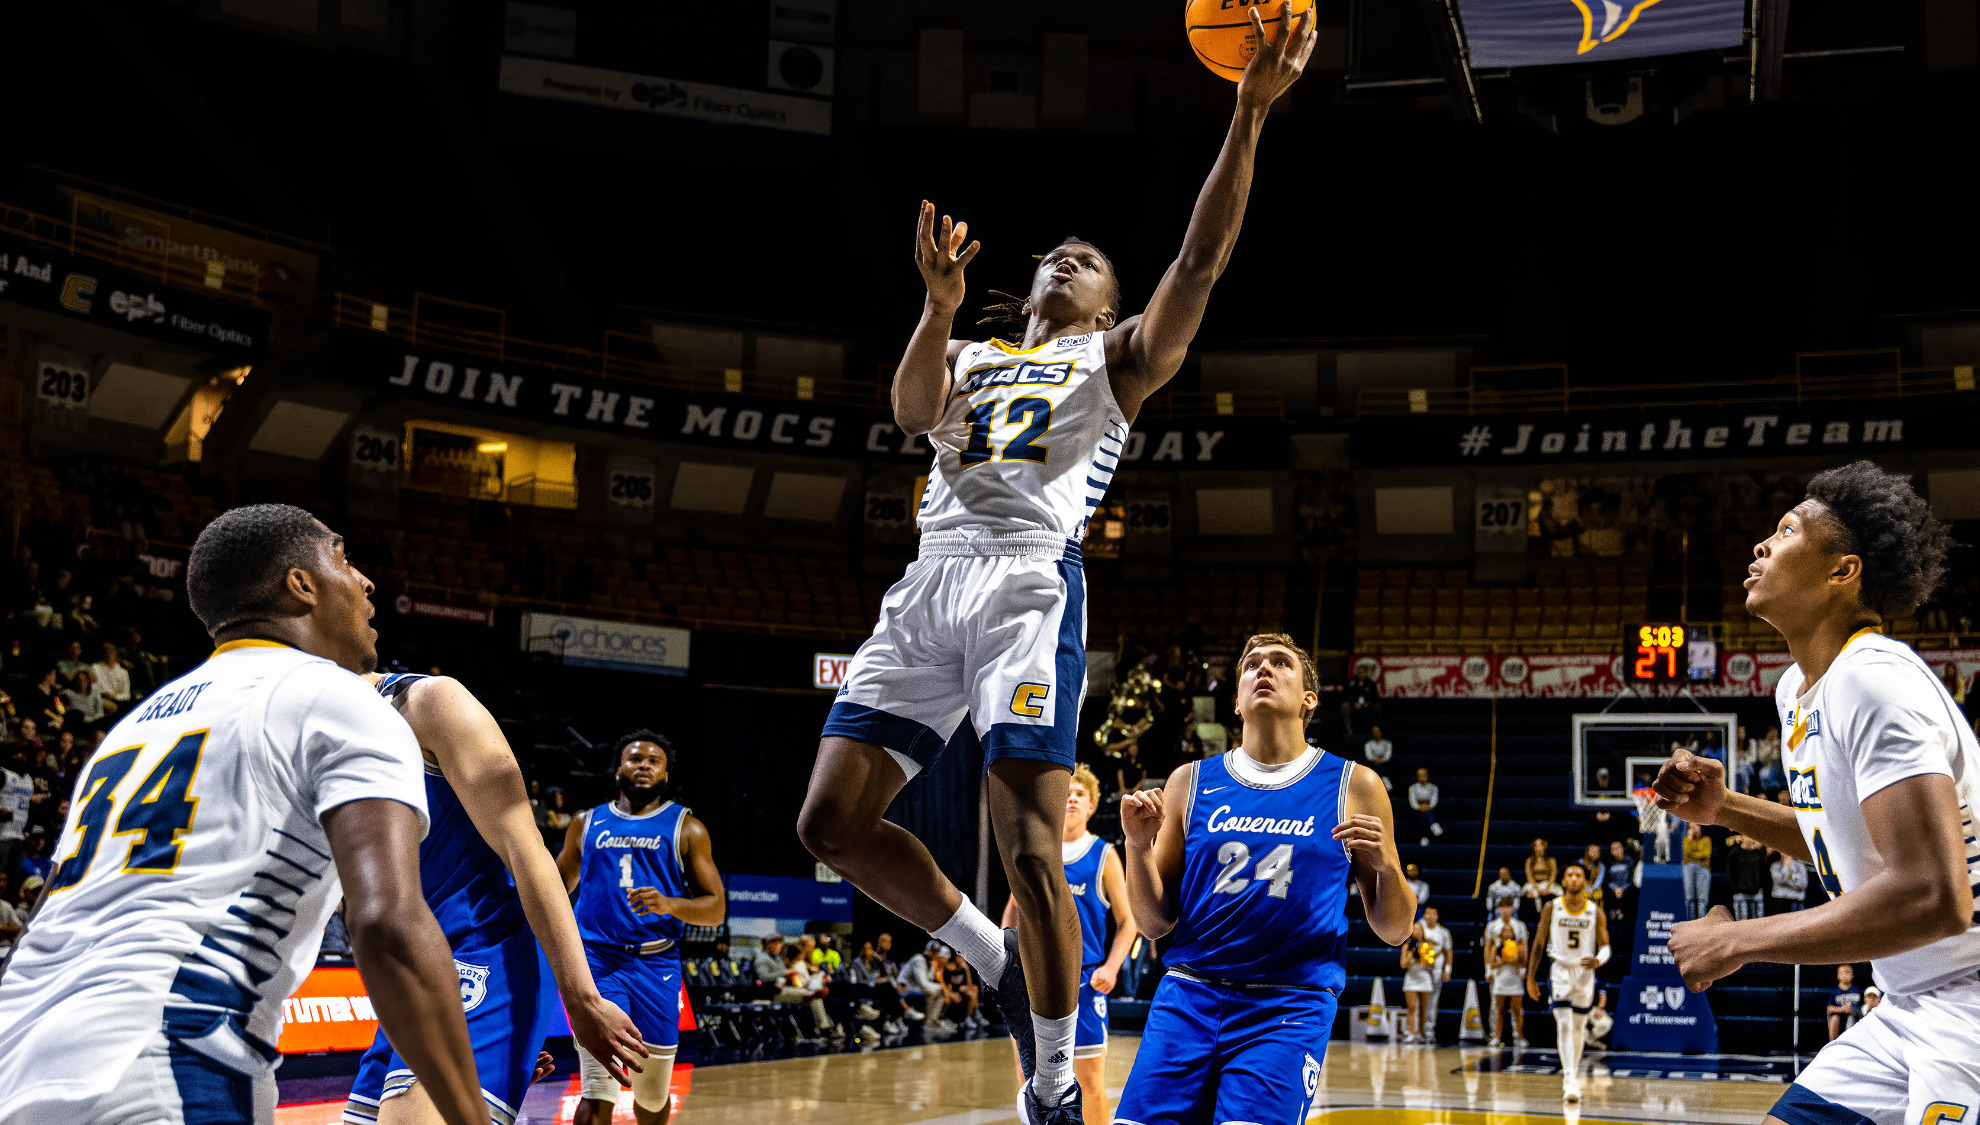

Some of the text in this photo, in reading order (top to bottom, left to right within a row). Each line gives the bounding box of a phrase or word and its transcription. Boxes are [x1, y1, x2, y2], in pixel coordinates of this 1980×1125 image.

[13, 254, 52, 283] And
[42, 367, 85, 402] 203
[388, 354, 524, 408] JOIN
[551, 382, 655, 429] THE
[680, 403, 836, 448] MOCS
[865, 422, 928, 455] CL
[959, 395, 1053, 468] 12
[357, 435, 396, 466] 204
[612, 474, 652, 500] 205
[1129, 503, 1170, 528] 206
[1481, 502, 1522, 527] 207
[1639, 625, 1685, 648] 5:03
[819, 659, 849, 684] EXI
[1634, 645, 1677, 679] 27
[136, 681, 213, 723] BRADY
[49, 727, 211, 896] 34
[1207, 804, 1315, 837] Covenant
[595, 829, 662, 850] Covenant
[619, 853, 634, 888] 1
[1213, 841, 1295, 899] 24
[1568, 930, 1580, 949] 5
[1629, 1013, 1641, 1025] of
